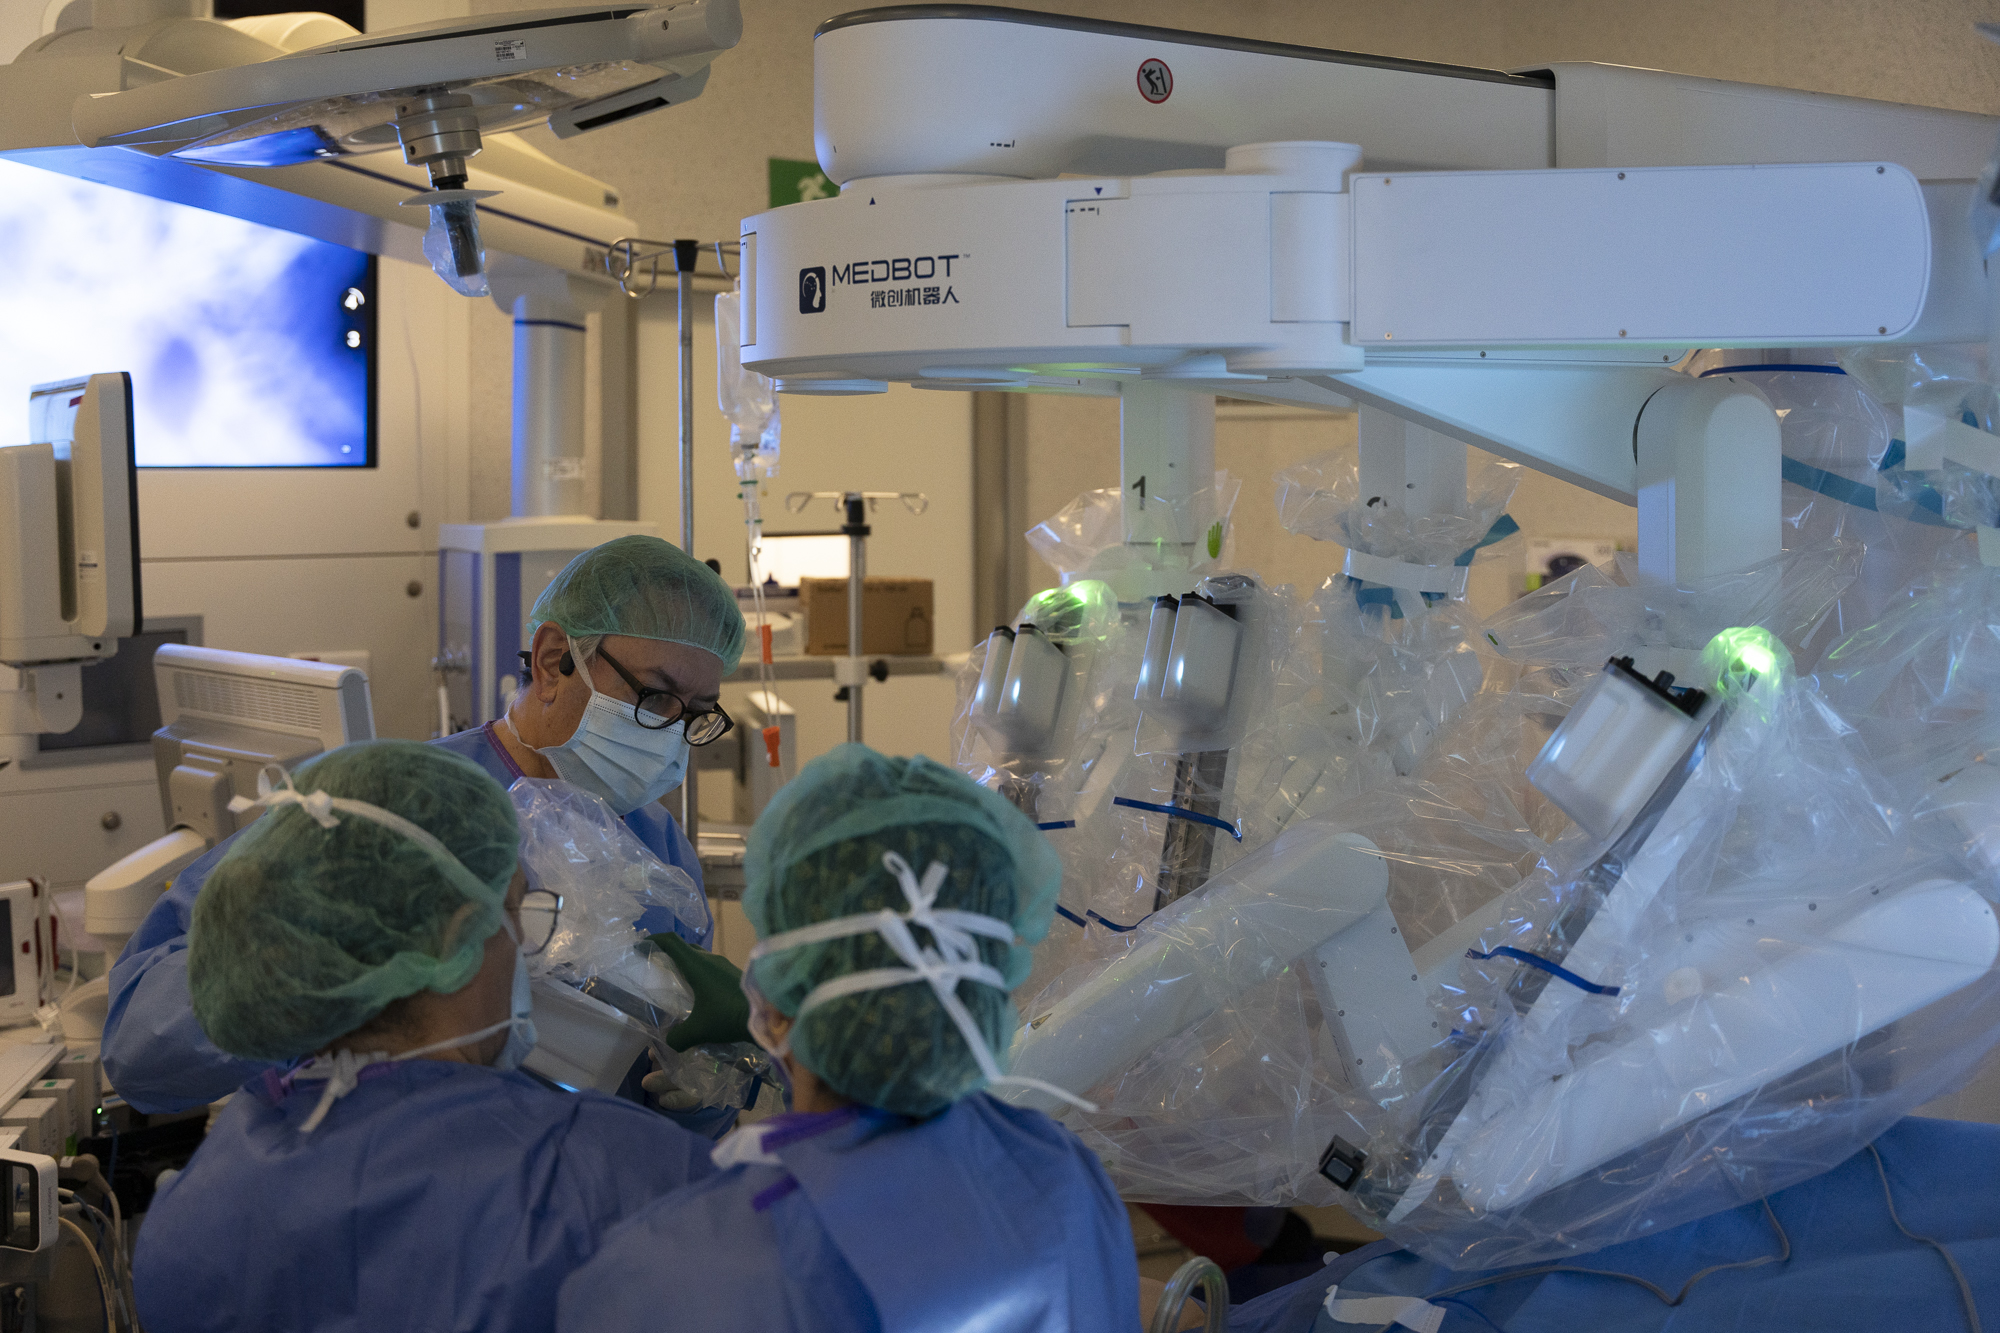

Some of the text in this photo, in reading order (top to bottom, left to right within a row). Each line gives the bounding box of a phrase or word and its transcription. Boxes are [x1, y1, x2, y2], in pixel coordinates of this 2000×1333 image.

[832, 254, 959, 286] MEDBOT
[870, 285, 960, 309] 微创机器人
[1132, 475, 1146, 511] 1
